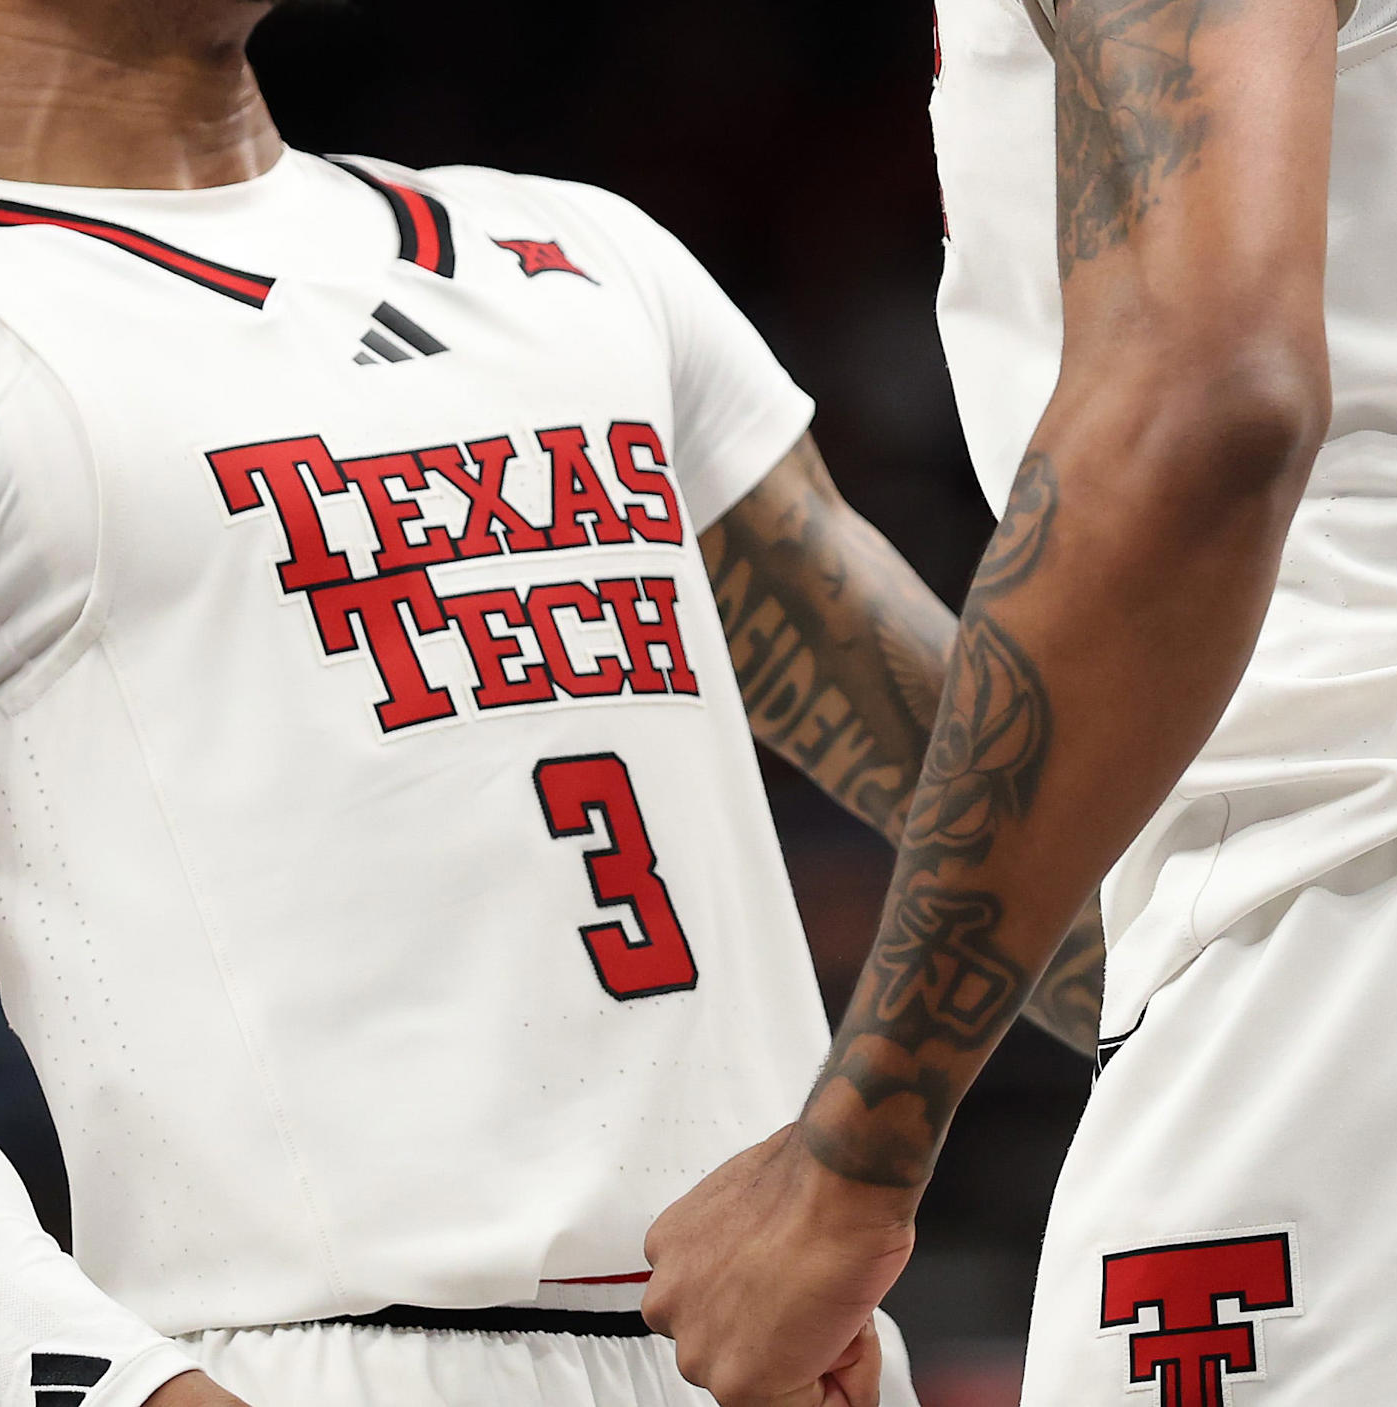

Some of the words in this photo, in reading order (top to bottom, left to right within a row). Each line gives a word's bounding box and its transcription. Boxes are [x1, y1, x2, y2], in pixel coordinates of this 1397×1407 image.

[205, 421, 684, 593] TEXAS
[306, 566, 700, 733] TECH
[533, 752, 699, 1001] 3
